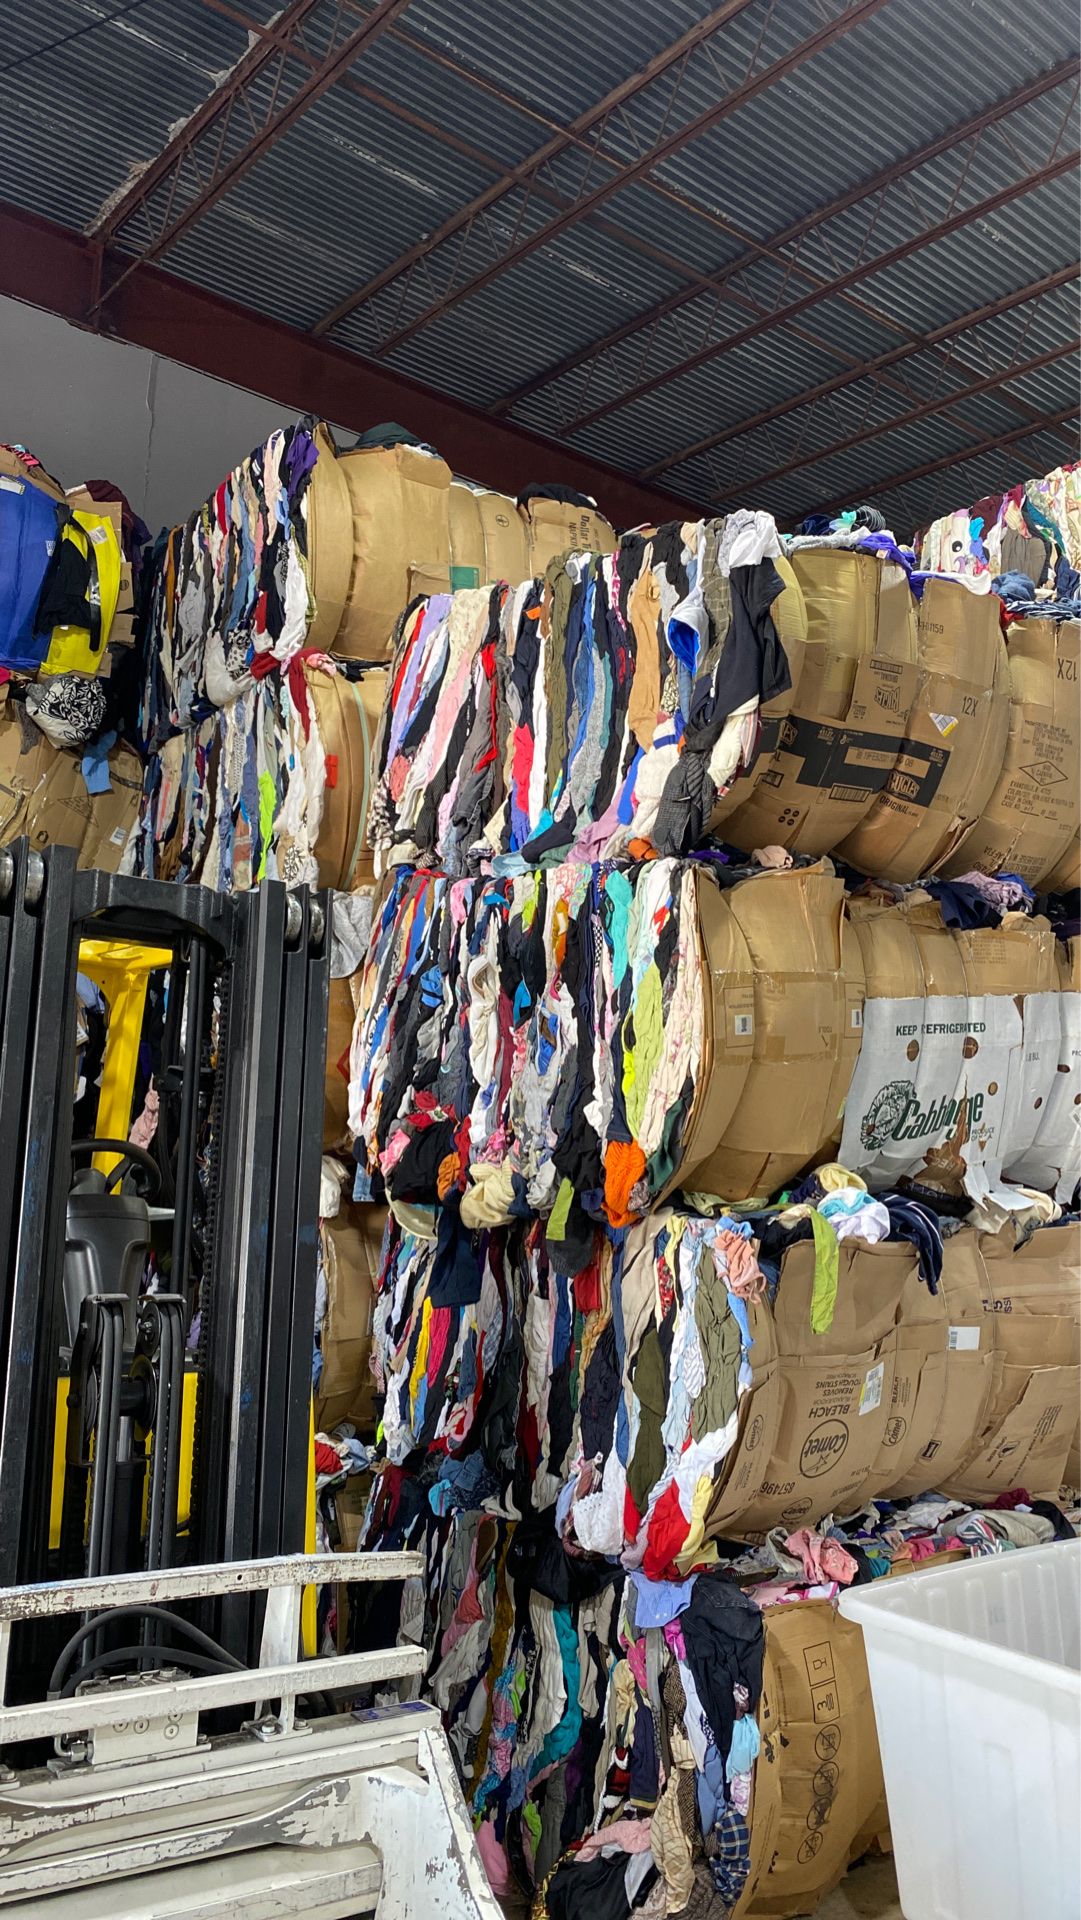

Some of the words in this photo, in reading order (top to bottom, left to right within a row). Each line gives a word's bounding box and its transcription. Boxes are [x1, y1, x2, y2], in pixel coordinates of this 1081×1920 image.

[580, 514, 590, 541] Dollar
[1057, 658, 1078, 683] 12X
[961, 695, 979, 718] 12X
[887, 768, 920, 800] BUGLES
[879, 795, 909, 815] ORIGINAL
[896, 1024, 918, 1037] KEEP
[921, 1022, 987, 1035] REFRIGERATED
[891, 1092, 985, 1145] Cabbage
[815, 1380, 840, 1389] STAINS
[823, 1387, 854, 1397] REMOVES
[840, 1379, 862, 1387] TOUGH
[808, 1403, 851, 1419] BLEACH
[888, 1419, 903, 1445] Comet
[803, 1432, 847, 1458] Comet
[760, 1480, 796, 1495] 857496
